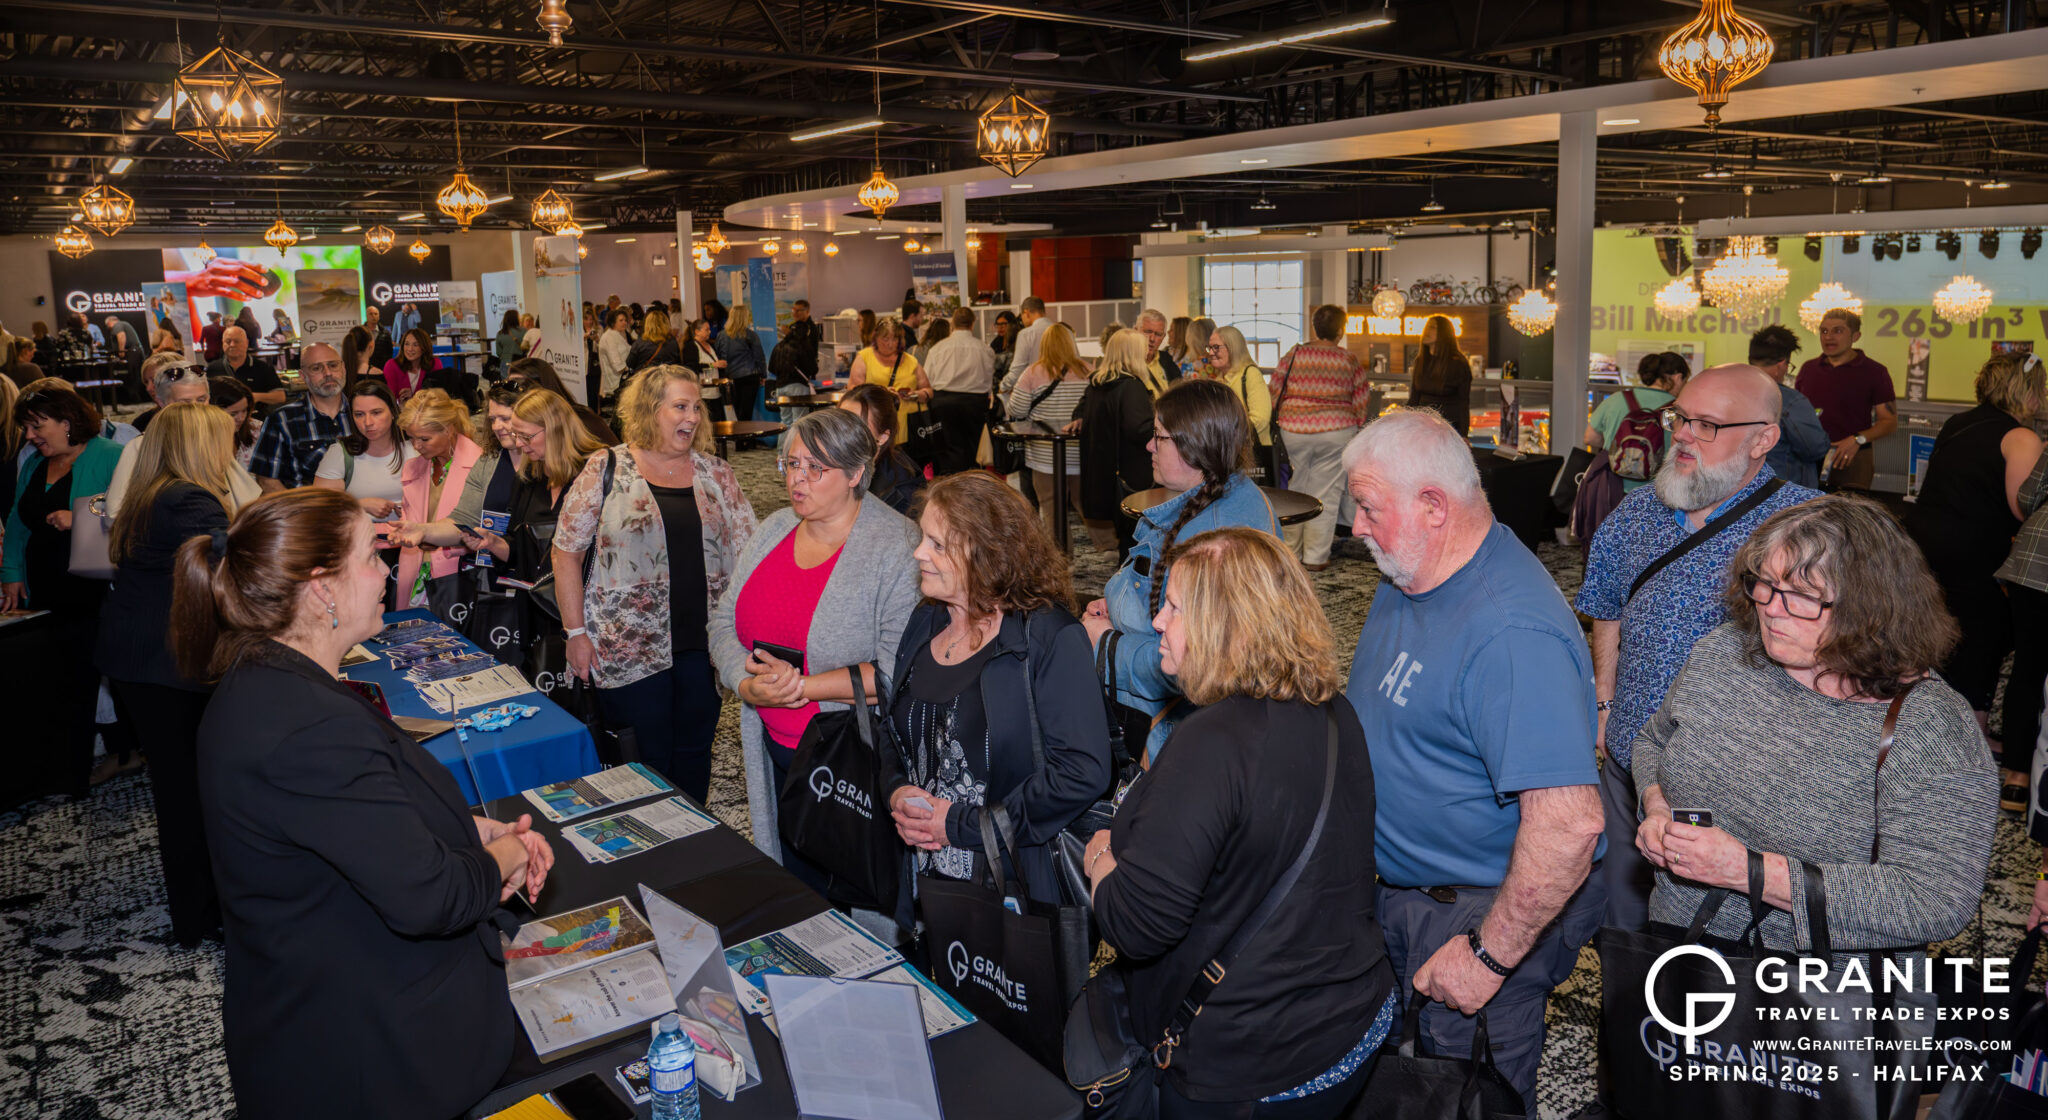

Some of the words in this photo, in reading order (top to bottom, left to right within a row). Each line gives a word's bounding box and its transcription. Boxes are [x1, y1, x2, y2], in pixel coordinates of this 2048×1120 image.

[93, 291, 145, 303] GRANIT
[393, 283, 438, 294] GRANIT
[1591, 304, 1634, 332] Bill
[1645, 304, 1781, 335] Mitchell
[1875, 307, 1953, 339] 265
[554, 352, 579, 367] GRANITE
[1378, 651, 1423, 707] AE
[836, 779, 872, 809] GRAN
[972, 975, 995, 992] TRAVEL
[973, 955, 1027, 1001] GRANTE
